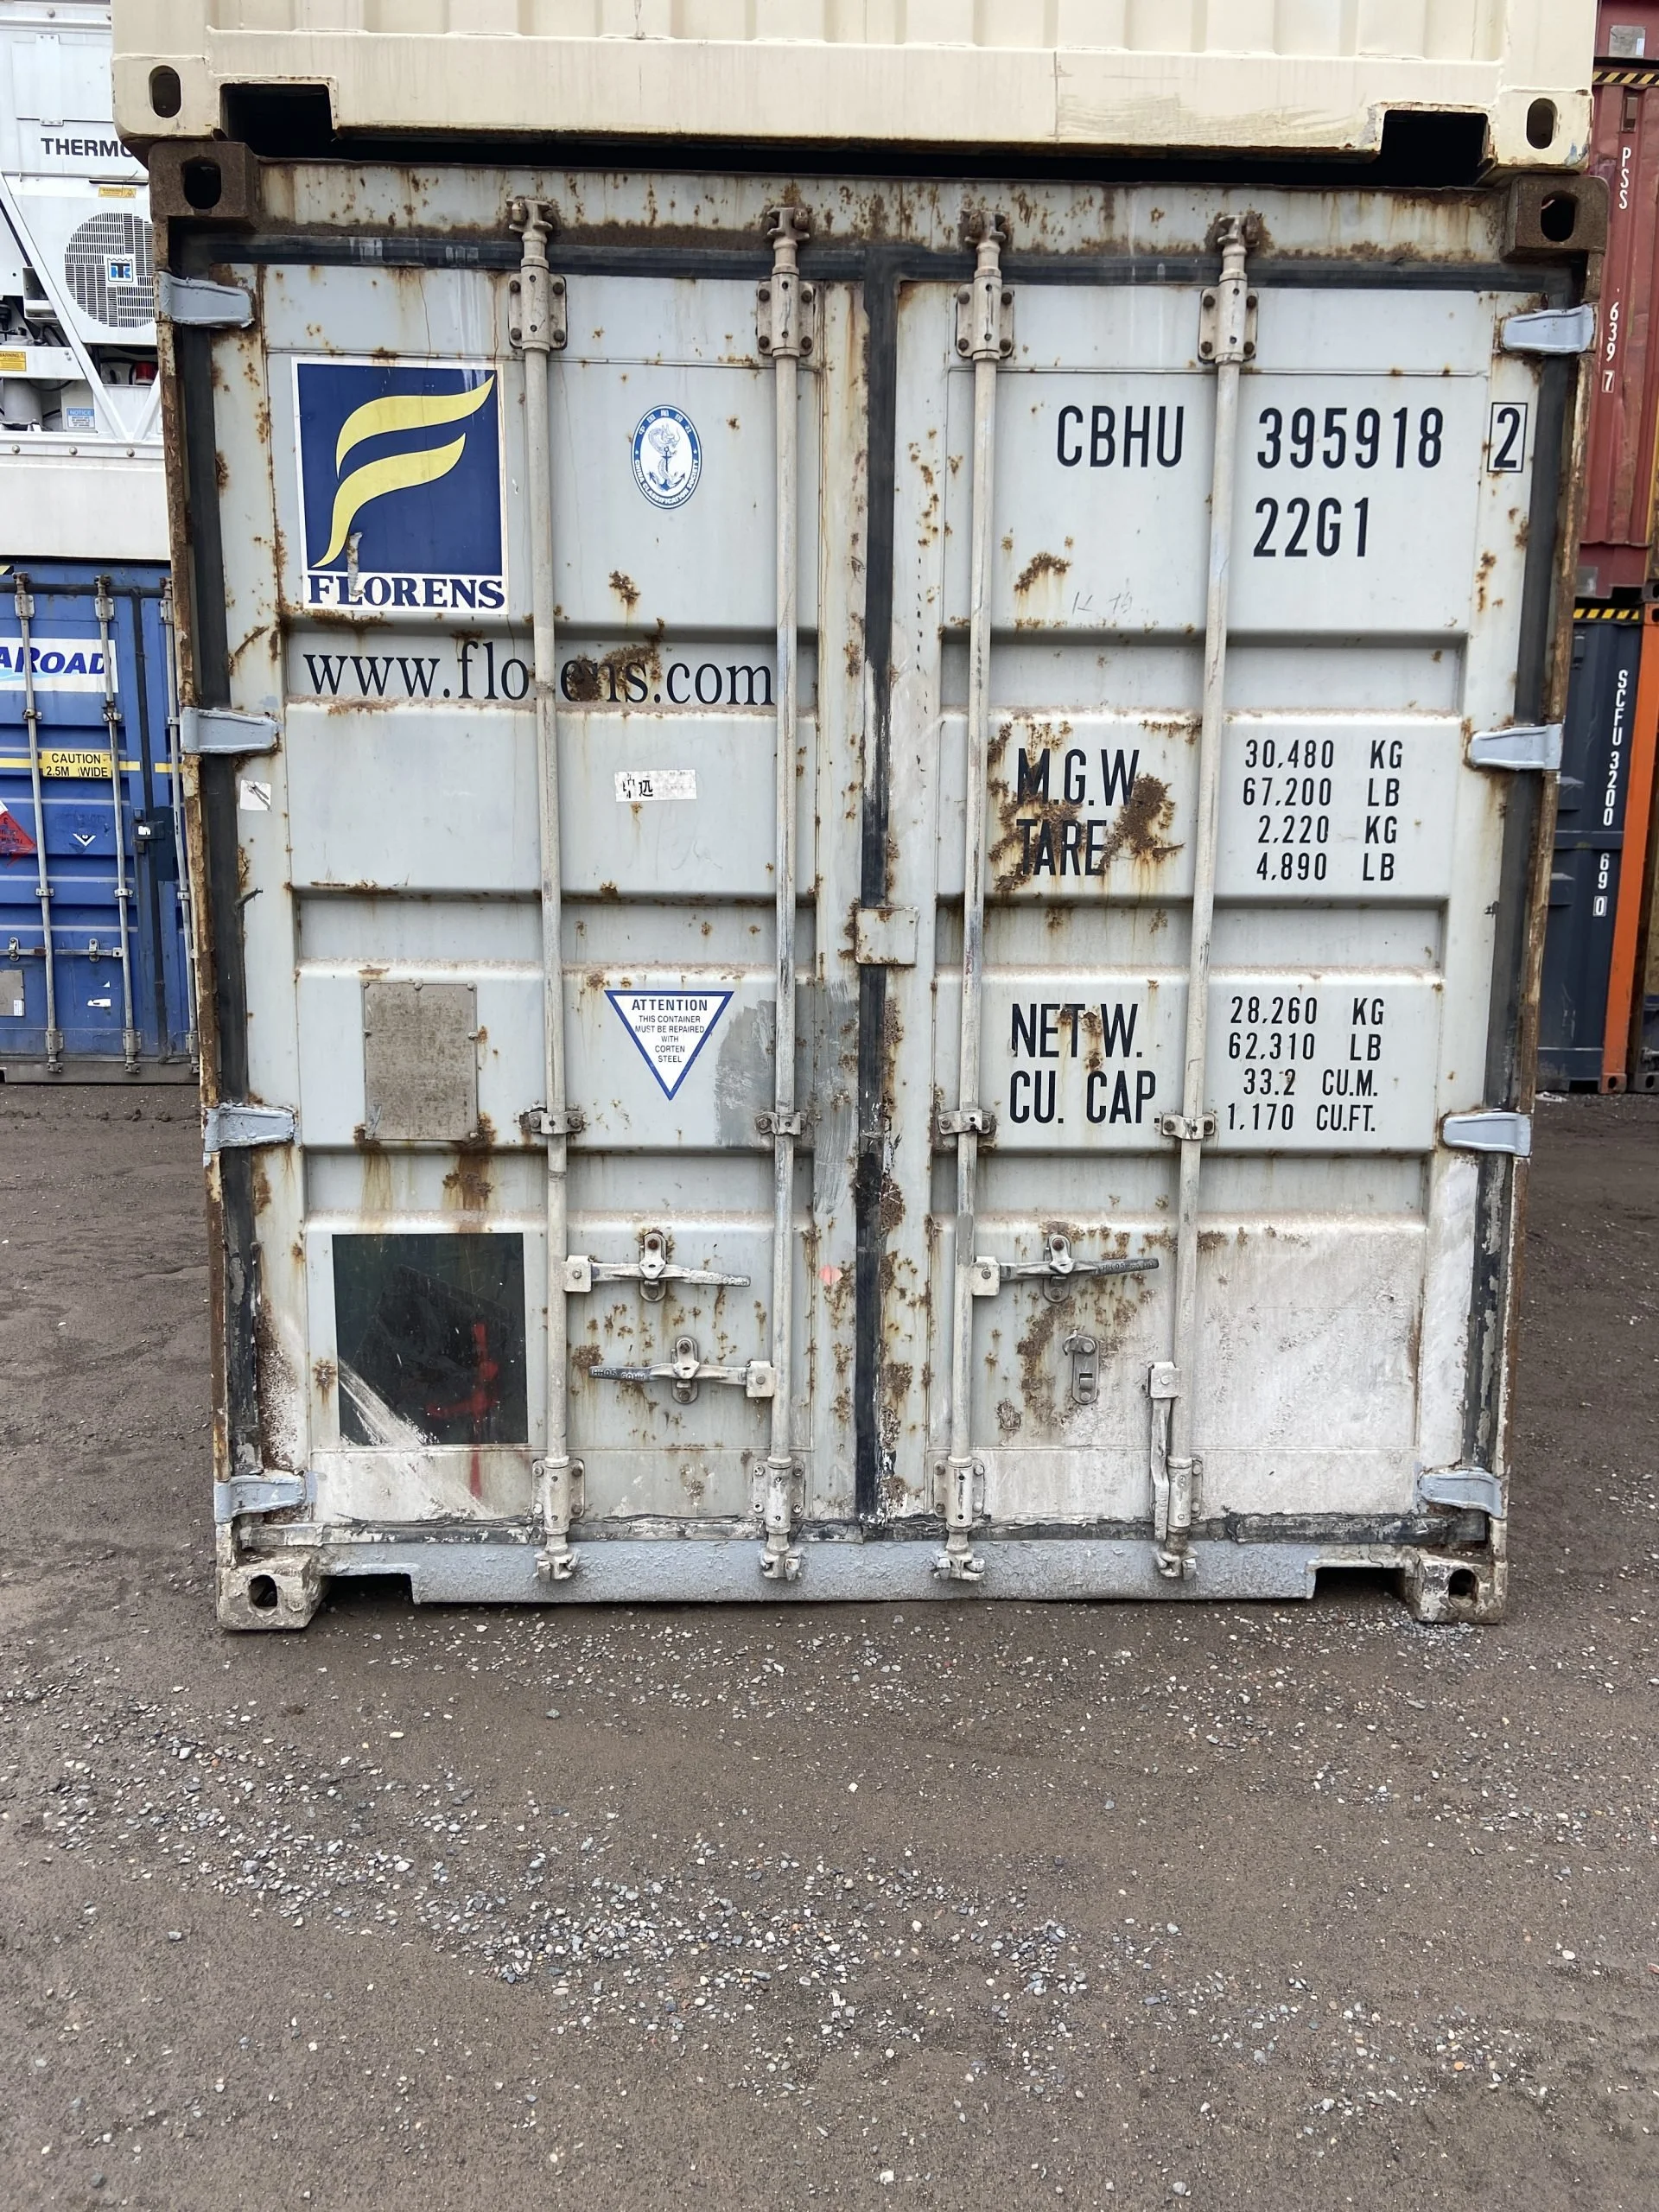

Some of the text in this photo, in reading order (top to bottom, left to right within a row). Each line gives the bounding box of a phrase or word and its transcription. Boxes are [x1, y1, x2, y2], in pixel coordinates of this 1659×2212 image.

[1057, 405, 1521, 469] CBHU 395918 2
[634, 459, 645, 484] CHINA
[642, 483, 690, 505] CLASSIFICATION
[1253, 497, 1369, 557] 22G1
[307, 574, 505, 609] FLORENS
[302, 640, 776, 707] www.floens.com
[1612, 670, 1629, 746] SCFU
[52, 753, 101, 764] CAUTION
[1245, 739, 1402, 769] 30,480 KG
[46, 766, 108, 777] 2.5M WIDE
[1243, 777, 1400, 807] 67,200 LB
[1258, 815, 1397, 844] 2,220 KG
[1016, 819, 1107, 876] TARE
[1256, 852, 1395, 881] 4,890 LB
[632, 999, 708, 1012] ATTENTION
[1230, 995, 1384, 1026] 28,260 KG
[1011, 1003, 1086, 1058] NET
[654, 1045, 685, 1053] CORTEN
[1229, 1032, 1382, 1061] 62,310 LB
[1243, 1067, 1379, 1096] 33.2 CU.M.
[1009, 1070, 1160, 1124] CU. CAP.
[1228, 1103, 1376, 1132] 1,170 CU.FT.
